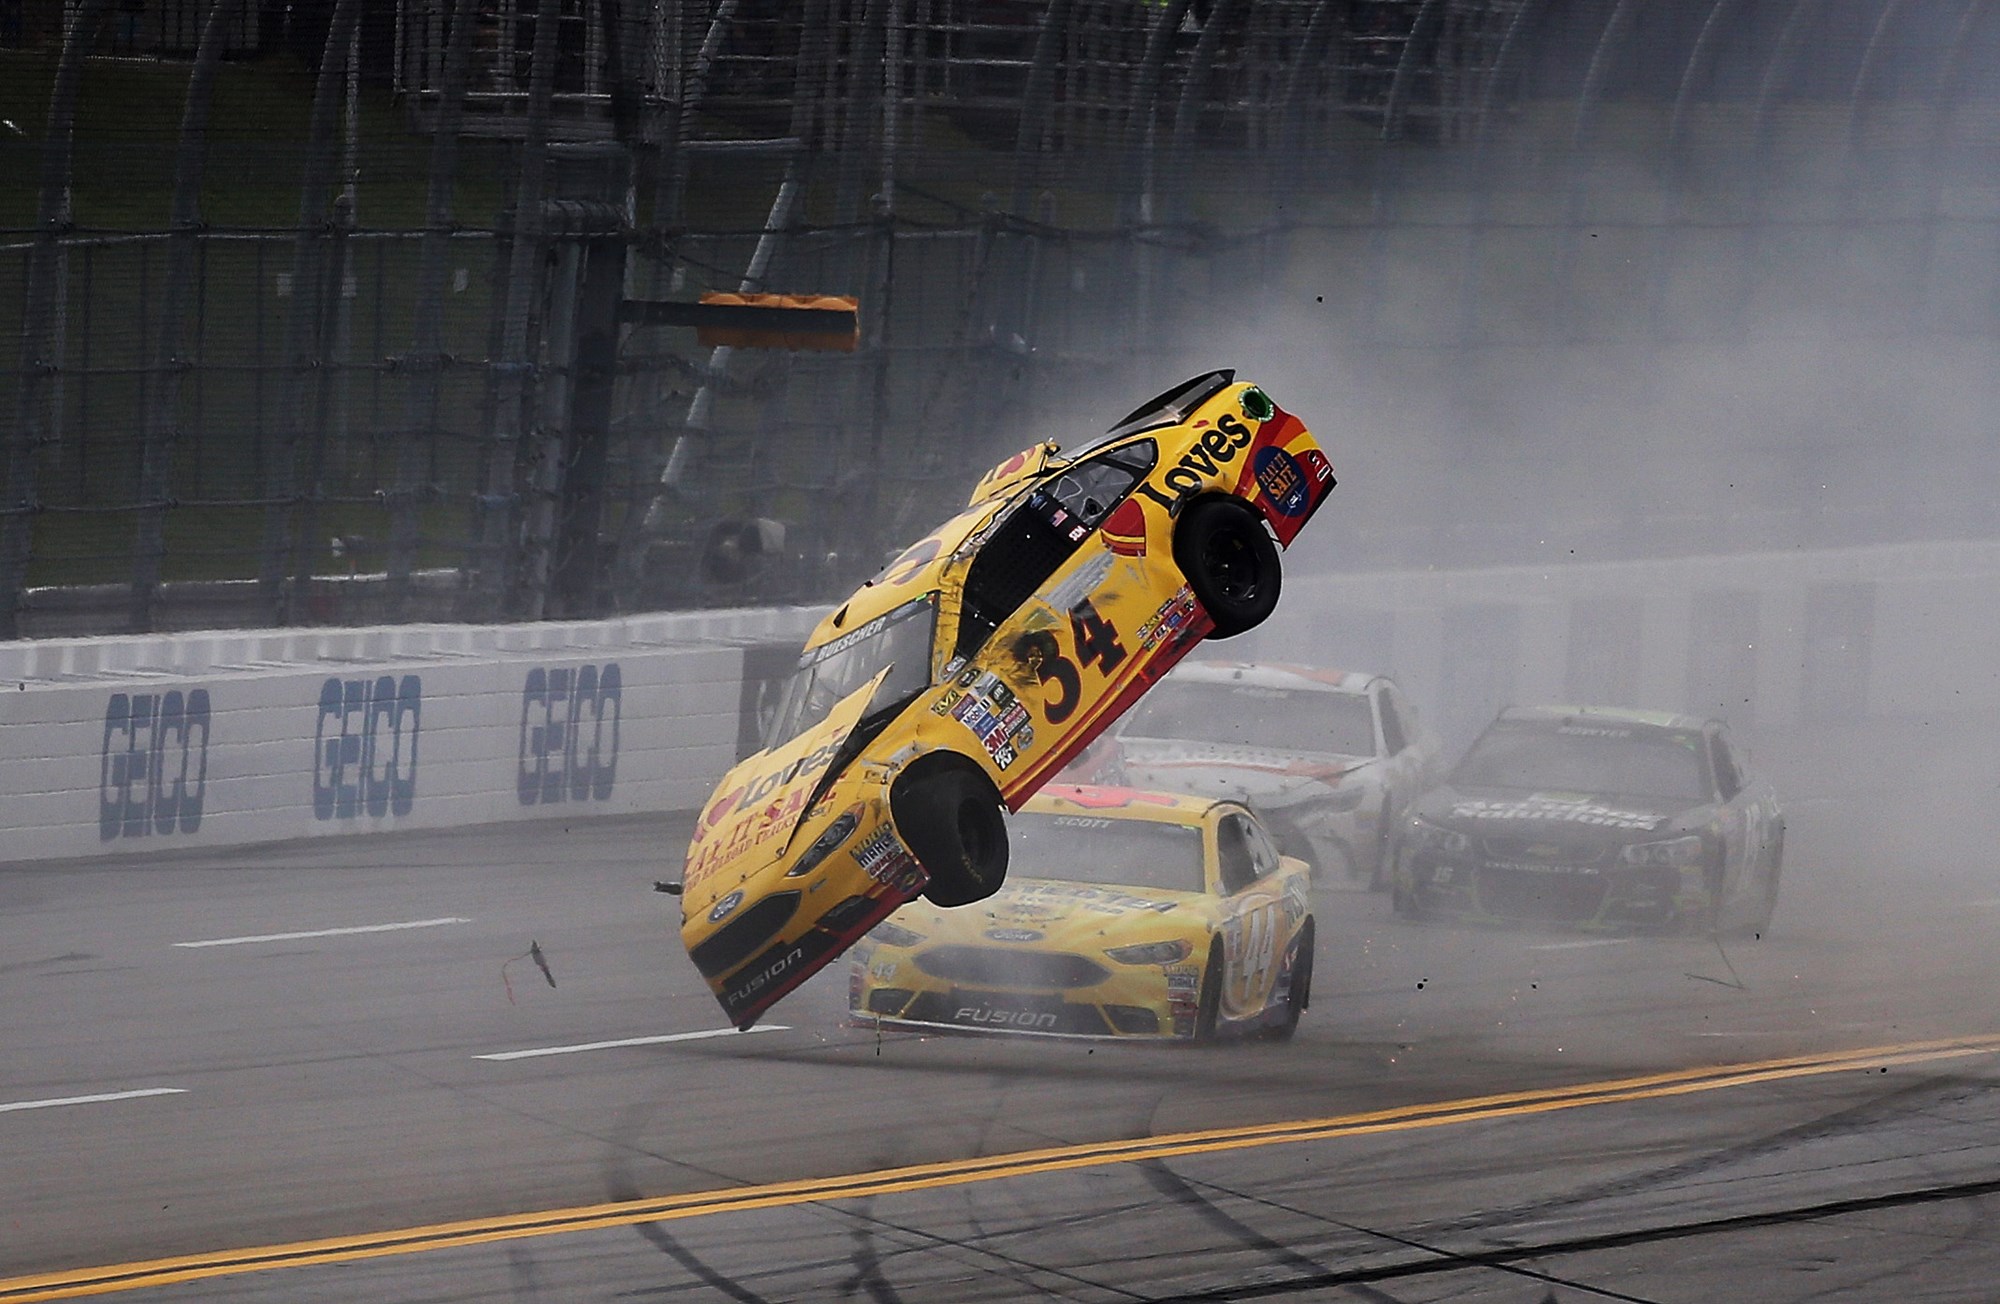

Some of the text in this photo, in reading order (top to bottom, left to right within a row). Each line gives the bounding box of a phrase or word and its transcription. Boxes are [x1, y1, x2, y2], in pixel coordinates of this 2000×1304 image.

[815, 617, 887, 662] BUESCHER
[1011, 597, 1128, 725] 34
[99, 689, 211, 842] GEICO
[314, 674, 422, 821] GEICO
[517, 663, 622, 806] GEICO
[984, 727, 1008, 755] 3M
[1054, 815, 1114, 829] SCOTT
[873, 962, 897, 979] 44
